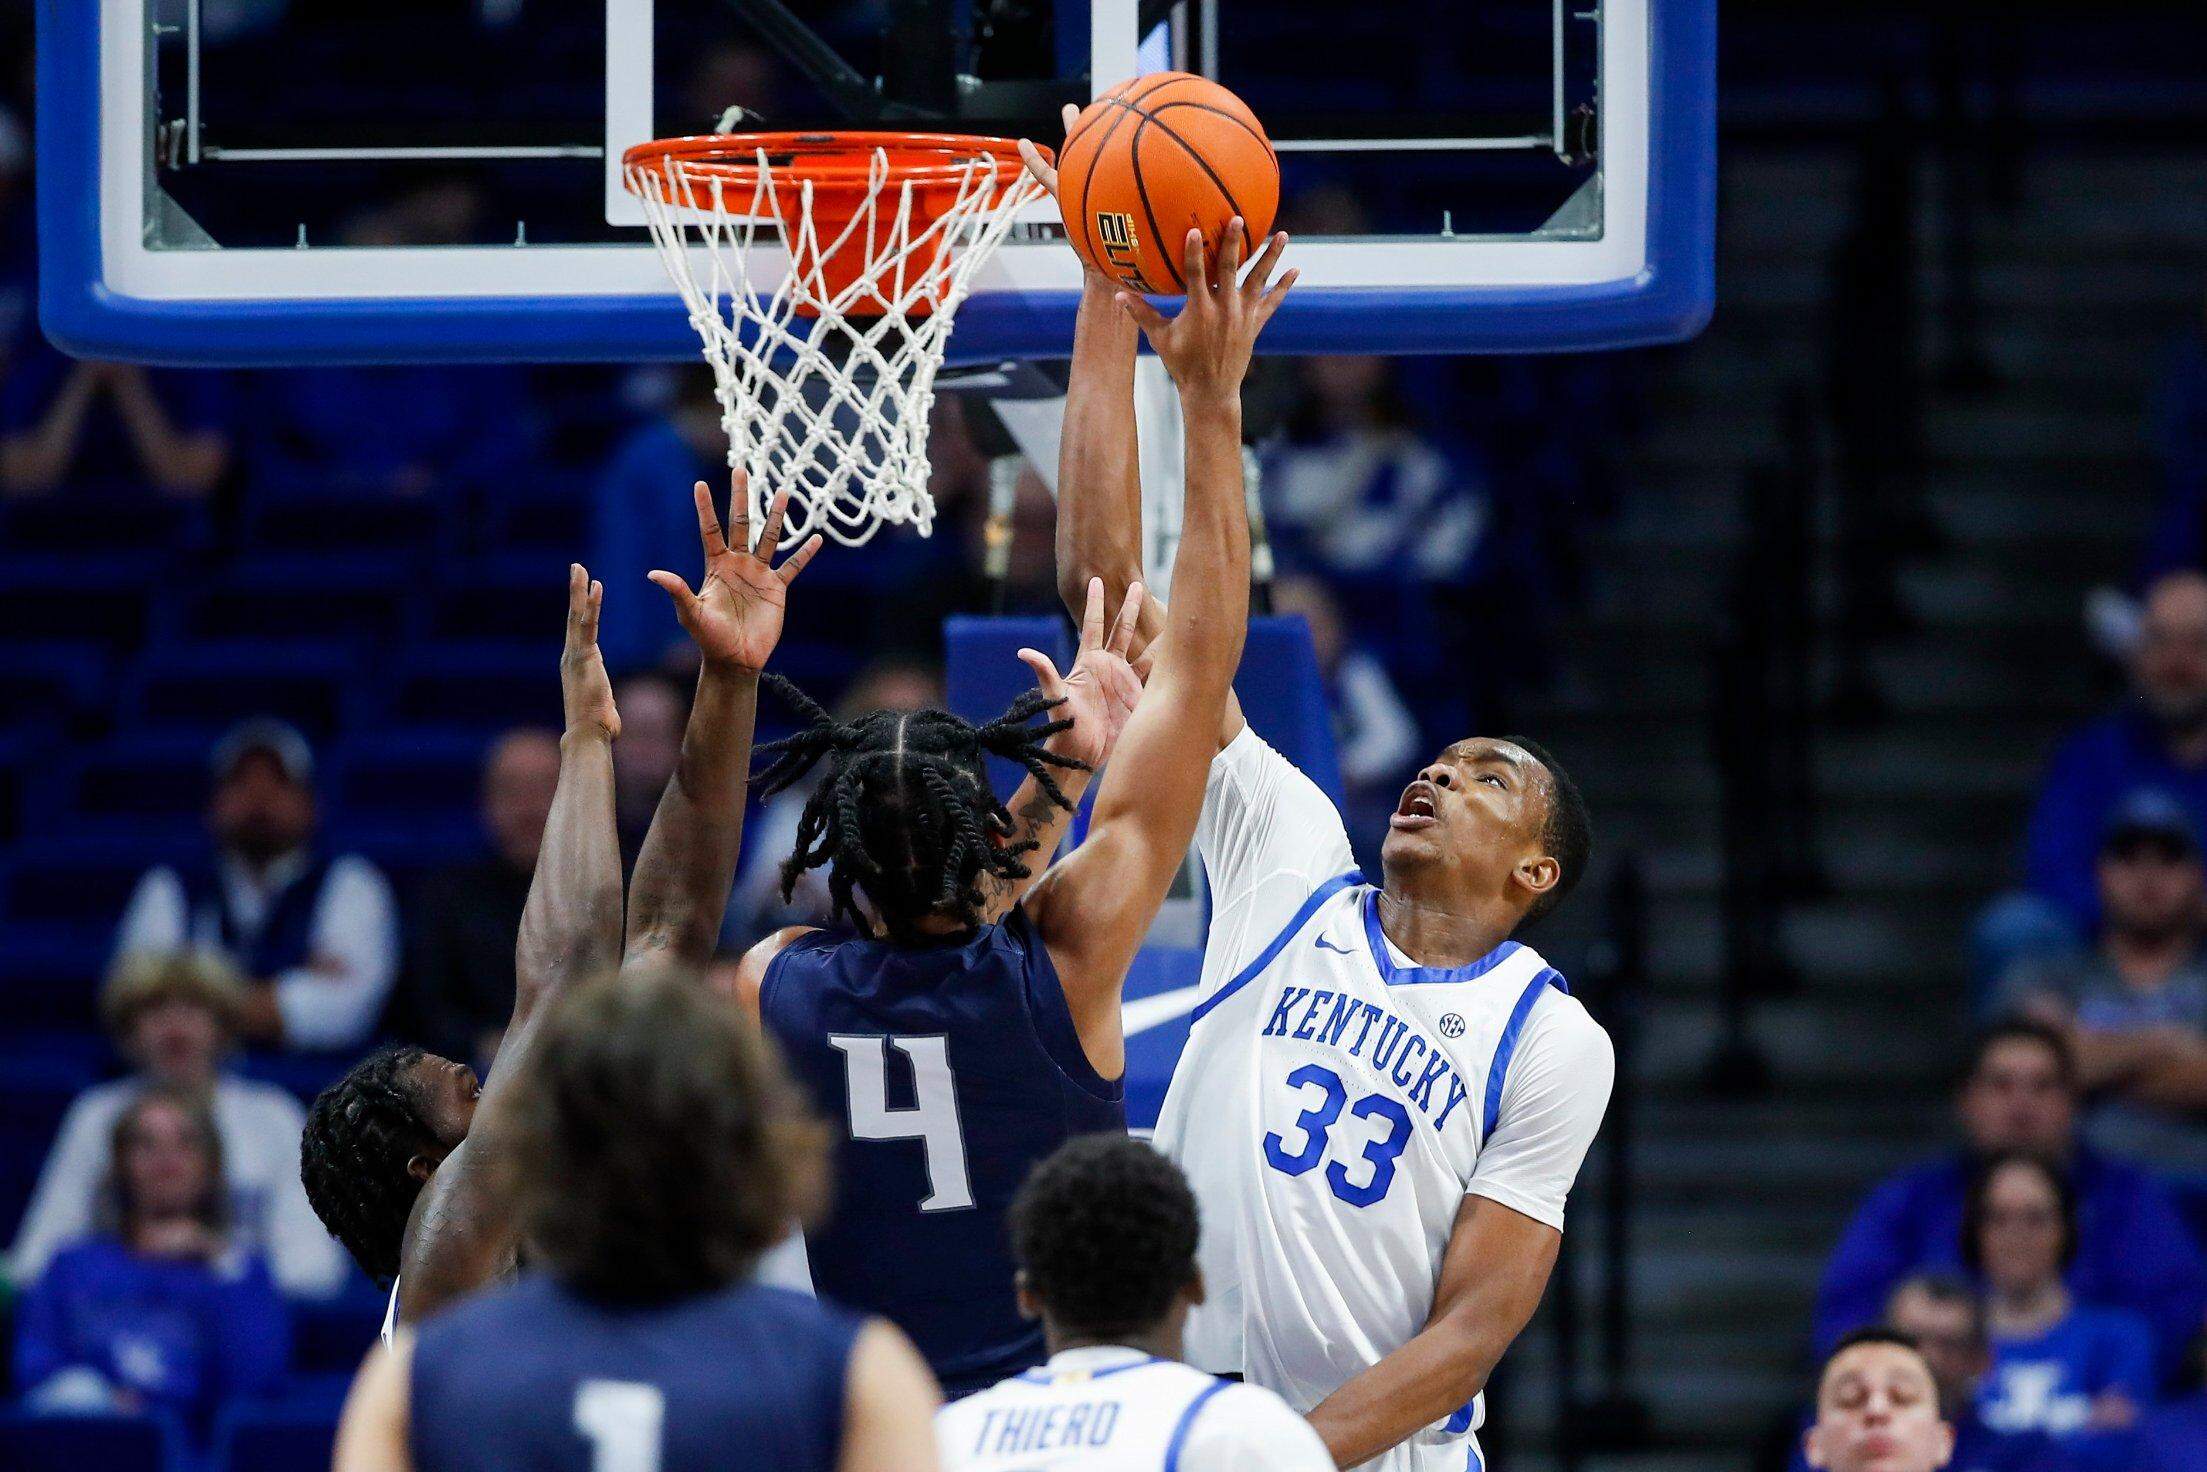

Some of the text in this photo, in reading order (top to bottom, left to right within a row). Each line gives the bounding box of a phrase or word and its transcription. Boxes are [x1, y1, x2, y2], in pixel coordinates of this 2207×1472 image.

[1262, 986, 1468, 1132] KENTUCKY
[1439, 1013, 1465, 1038] SEC
[827, 1032, 978, 1214] 4
[1262, 1063, 1414, 1208] 33
[574, 1379, 665, 1472] 1
[973, 1400, 1122, 1455] THIERO
